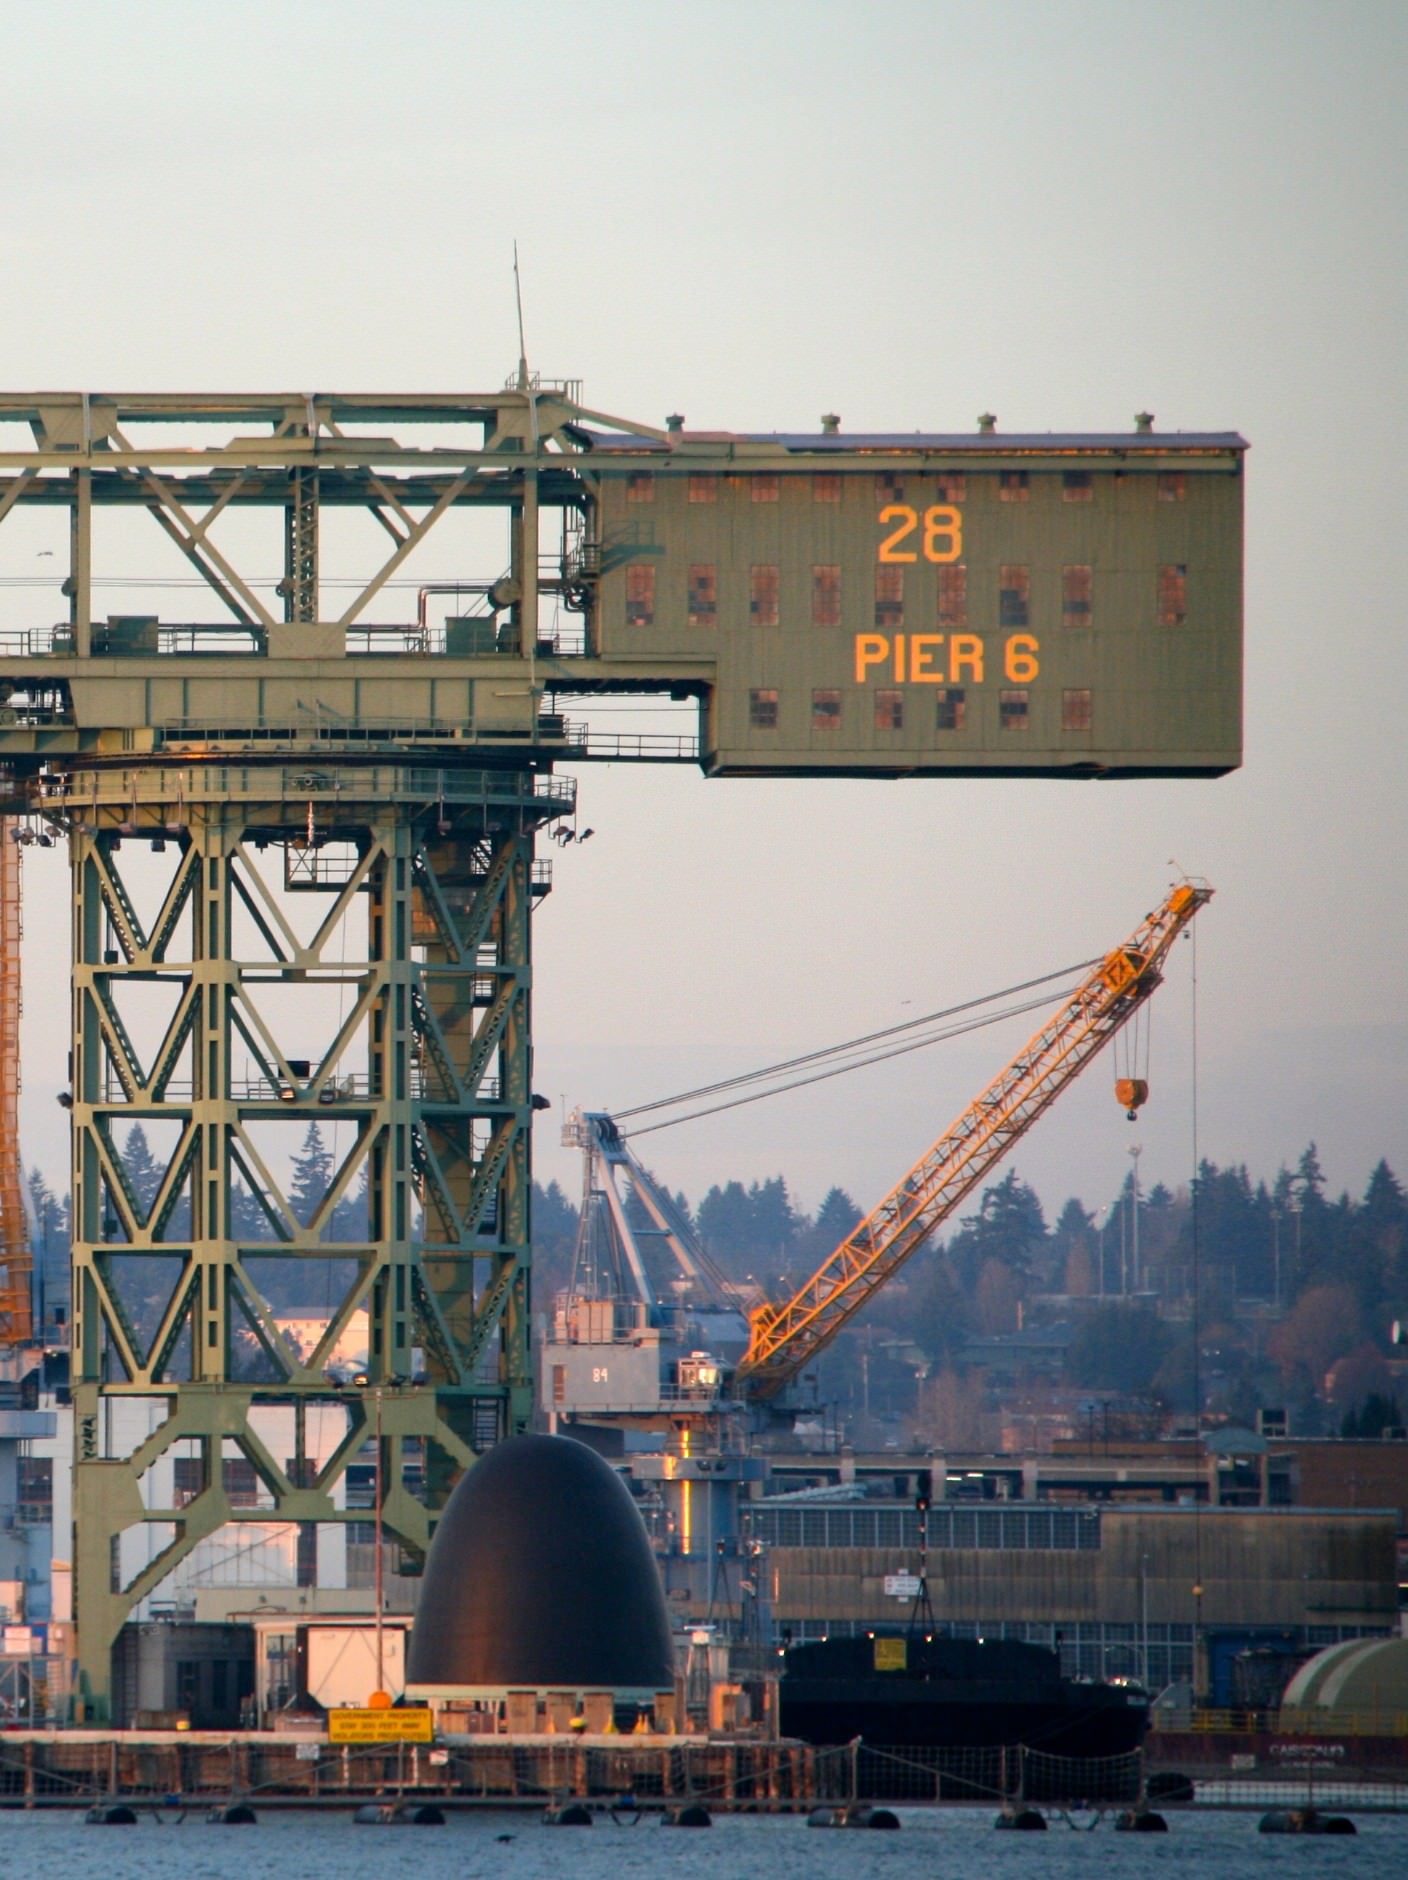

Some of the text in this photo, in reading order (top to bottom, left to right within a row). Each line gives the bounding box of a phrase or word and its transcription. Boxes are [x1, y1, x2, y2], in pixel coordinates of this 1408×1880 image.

[878, 505, 963, 563] 28
[855, 633, 1040, 683] PIER 6
[592, 1367, 609, 1383] 84
[332, 1711, 428, 1720] GOVERNMENT PROPERTY
[377, 1722, 398, 1730] FEET
